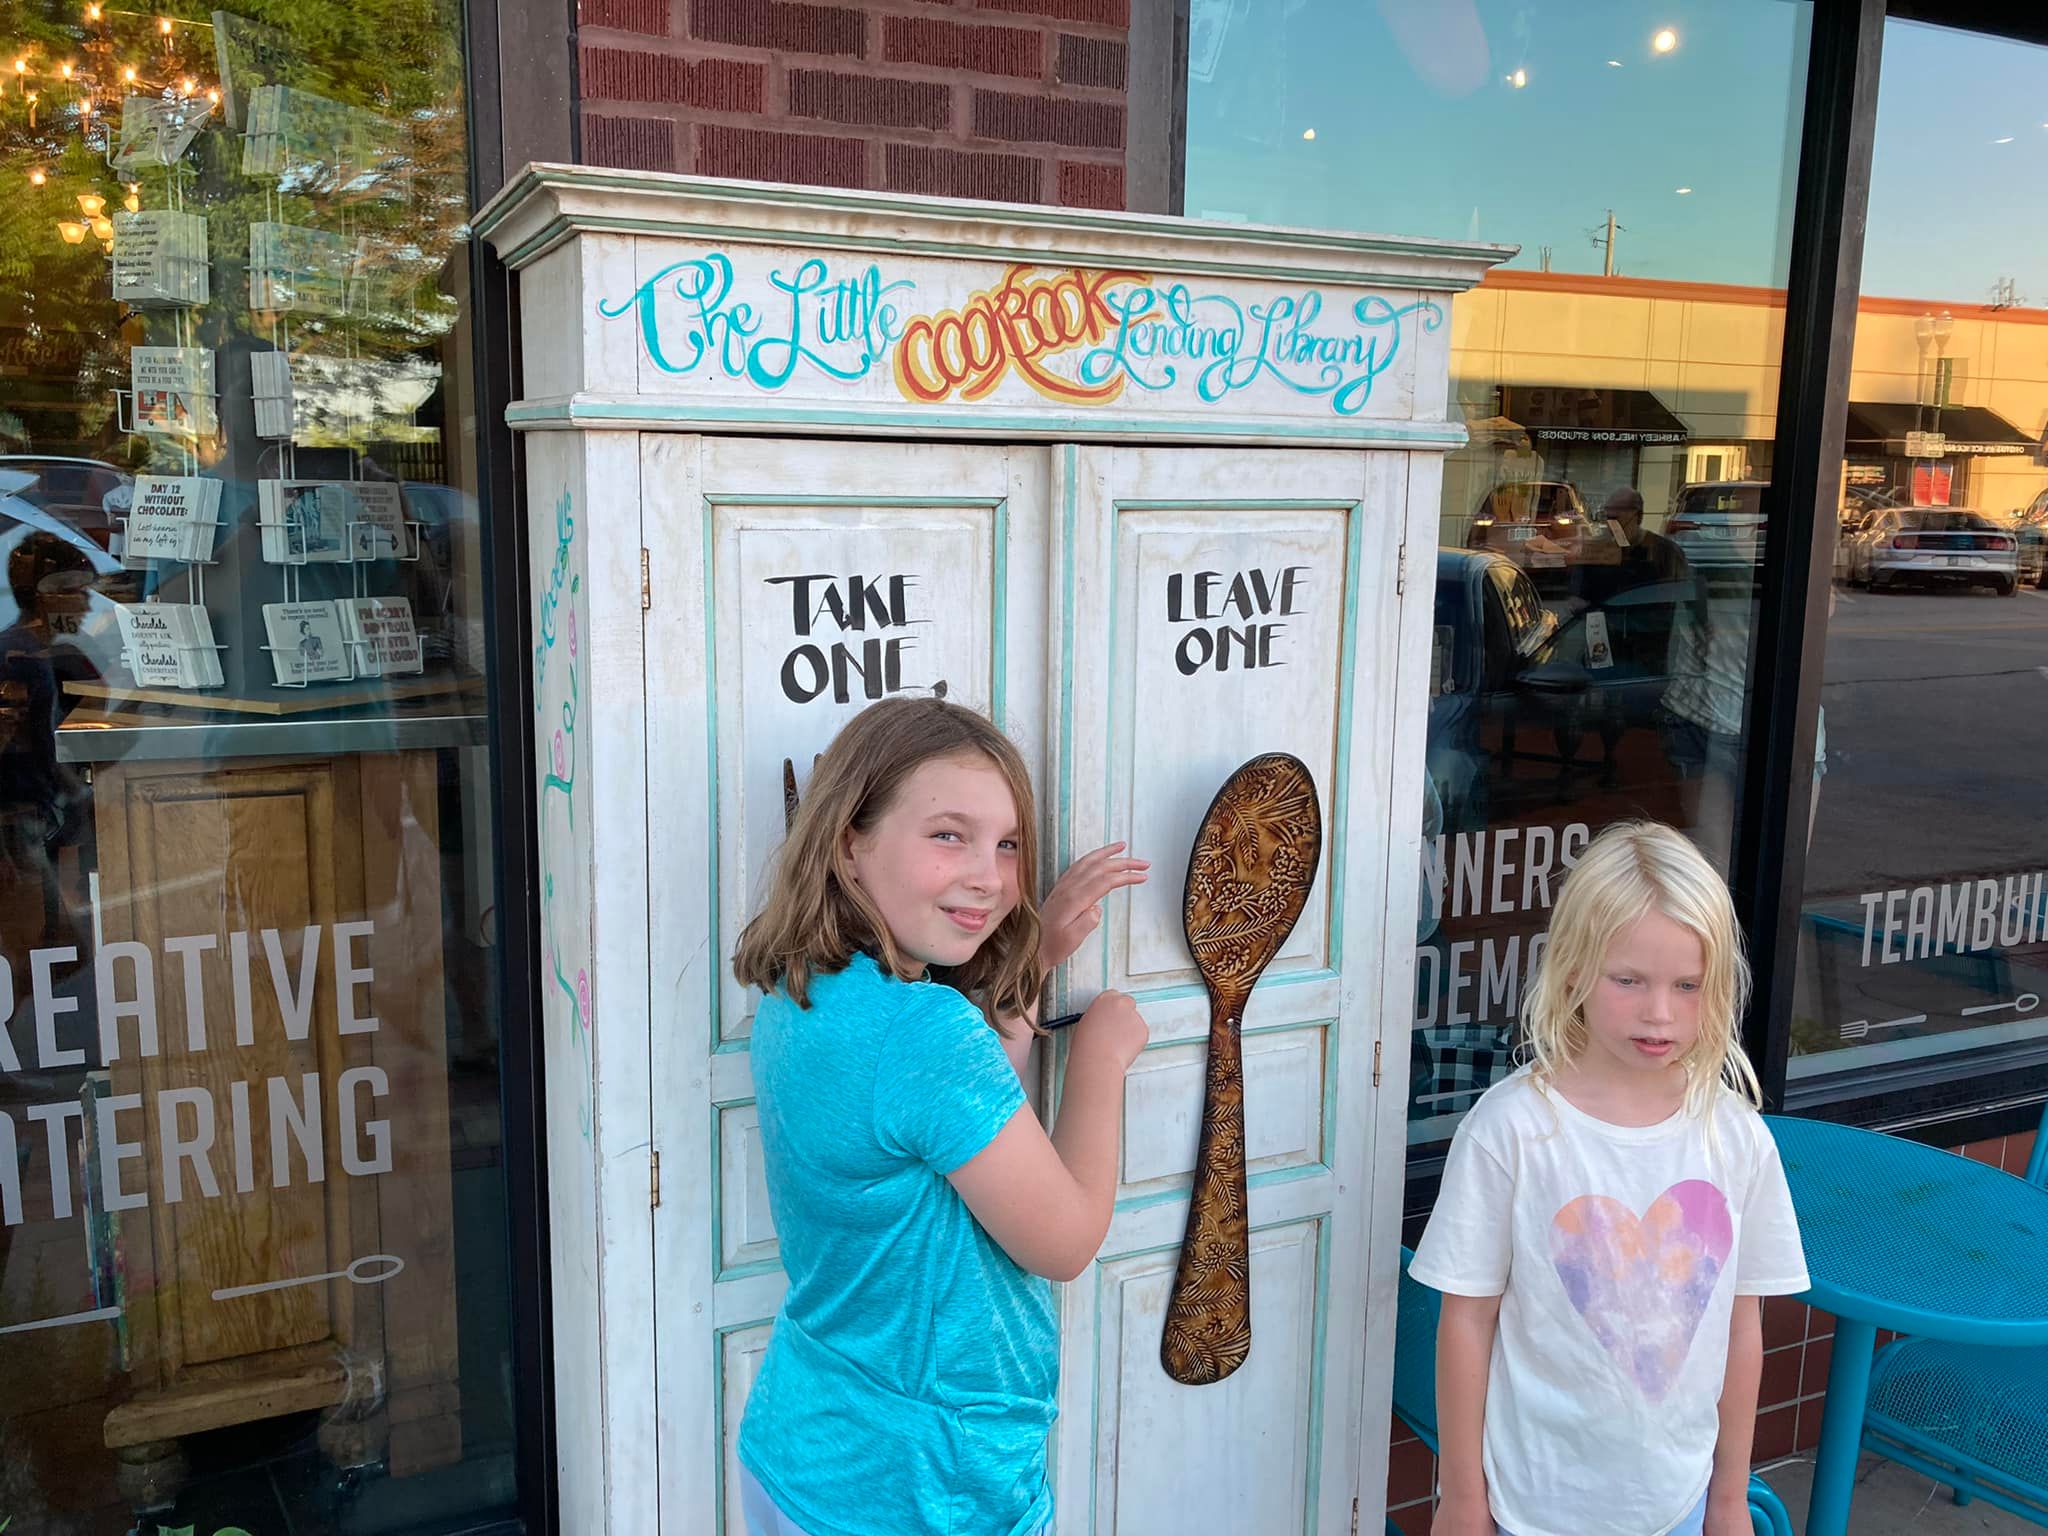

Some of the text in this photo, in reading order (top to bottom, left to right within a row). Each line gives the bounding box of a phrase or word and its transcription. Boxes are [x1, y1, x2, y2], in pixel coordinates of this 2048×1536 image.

[600, 252, 763, 377] The
[747, 258, 916, 389] Little
[1079, 283, 1244, 402] Lending
[1227, 289, 1443, 415] Library
[137, 505, 189, 517] CHOCOLATE:
[144, 495, 185, 506] WITHOUT
[150, 484, 181, 494] DAY 12
[763, 574, 934, 637] TAKE
[1167, 566, 1313, 623] LEAVE
[131, 616, 168, 630] Chocolate
[1175, 623, 1289, 676] ONE
[141, 652, 177, 666] Chocolate
[780, 636, 927, 705] ONE
[1860, 872, 2048, 968] TEAMBUI
